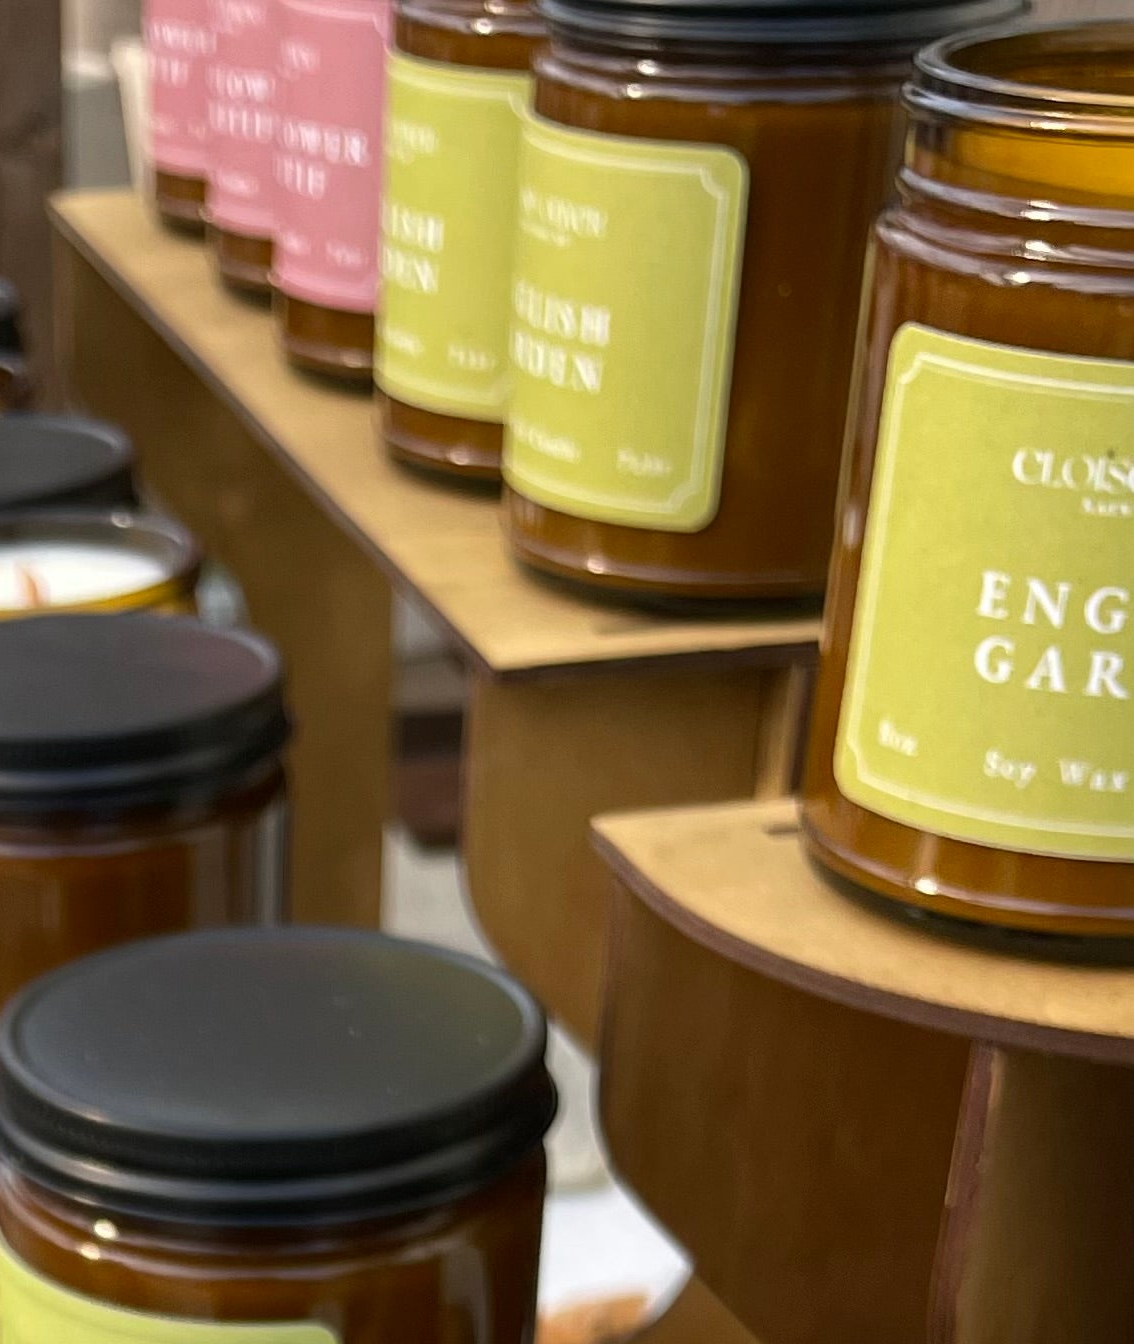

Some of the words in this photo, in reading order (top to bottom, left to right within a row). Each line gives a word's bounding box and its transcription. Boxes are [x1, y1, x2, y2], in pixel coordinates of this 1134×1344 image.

[976, 569, 1130, 635] ENG
[974, 634, 1131, 700] GAR
[984, 749, 1036, 789] Soy
[1059, 758, 1130, 792] Wax
